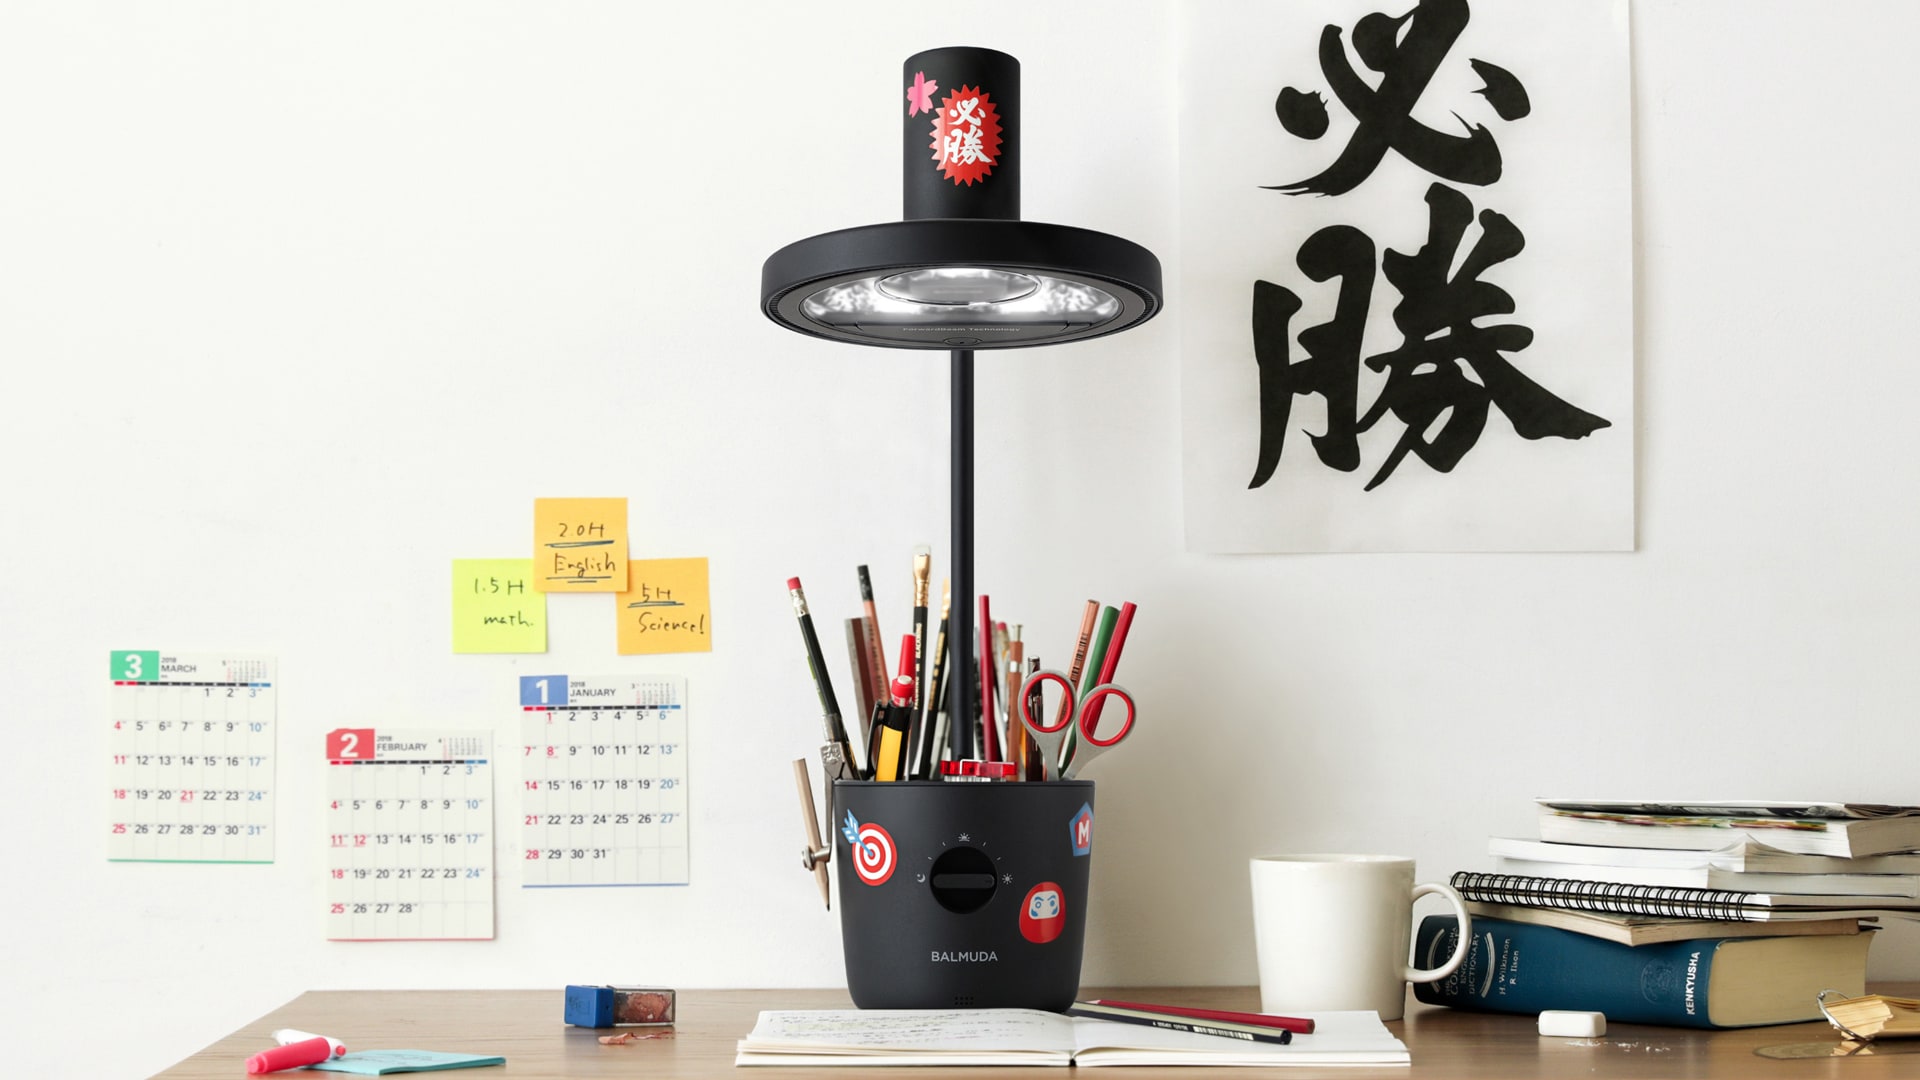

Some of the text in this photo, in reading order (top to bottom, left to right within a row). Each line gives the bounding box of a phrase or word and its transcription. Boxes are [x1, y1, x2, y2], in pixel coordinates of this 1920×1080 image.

[943, 97, 992, 166] 必勝
[1247, 0, 1612, 492] 必勝
[555, 553, 616, 578] English
[639, 612, 705, 634] Science!
[125, 655, 142, 678] 3
[204, 689, 256, 698] 1 2 3
[536, 680, 548, 704] 1
[546, 711, 666, 721] 1 2 3 4 5 6
[114, 721, 262, 731] 4 5 6 7 8 9 10
[340, 734, 358, 757] 2
[525, 746, 673, 756] 7 8 9 10 11 12 13
[114, 756, 261, 766] 11 12 13 14 15 16 17
[420, 766, 473, 775] 1 2 3
[525, 780, 673, 790] 14 15 16 17 18 19 20
[114, 790, 261, 800] 18 19 20 21 22 23 24
[331, 800, 479, 809] 4 5 6 7 8 9 10
[525, 814, 674, 825] 21 22 23 24 25 26 27
[112, 825, 261, 834] 25 26 27 28 29 30 31
[1078, 820, 1090, 845] M
[331, 835, 479, 844] 11 12 13 14 15 16 17
[526, 850, 606, 859] 28 29 30 31
[331, 870, 479, 879] 18 19 20 21 22 23 24
[331, 904, 412, 913] 25 26 27 28
[931, 951, 998, 962] BALMUDA
[1499, 938, 1510, 983] Wilkinson
[1469, 933, 1480, 994] DICTIONARY
[1686, 952, 1700, 1014] KENKYUSHA
